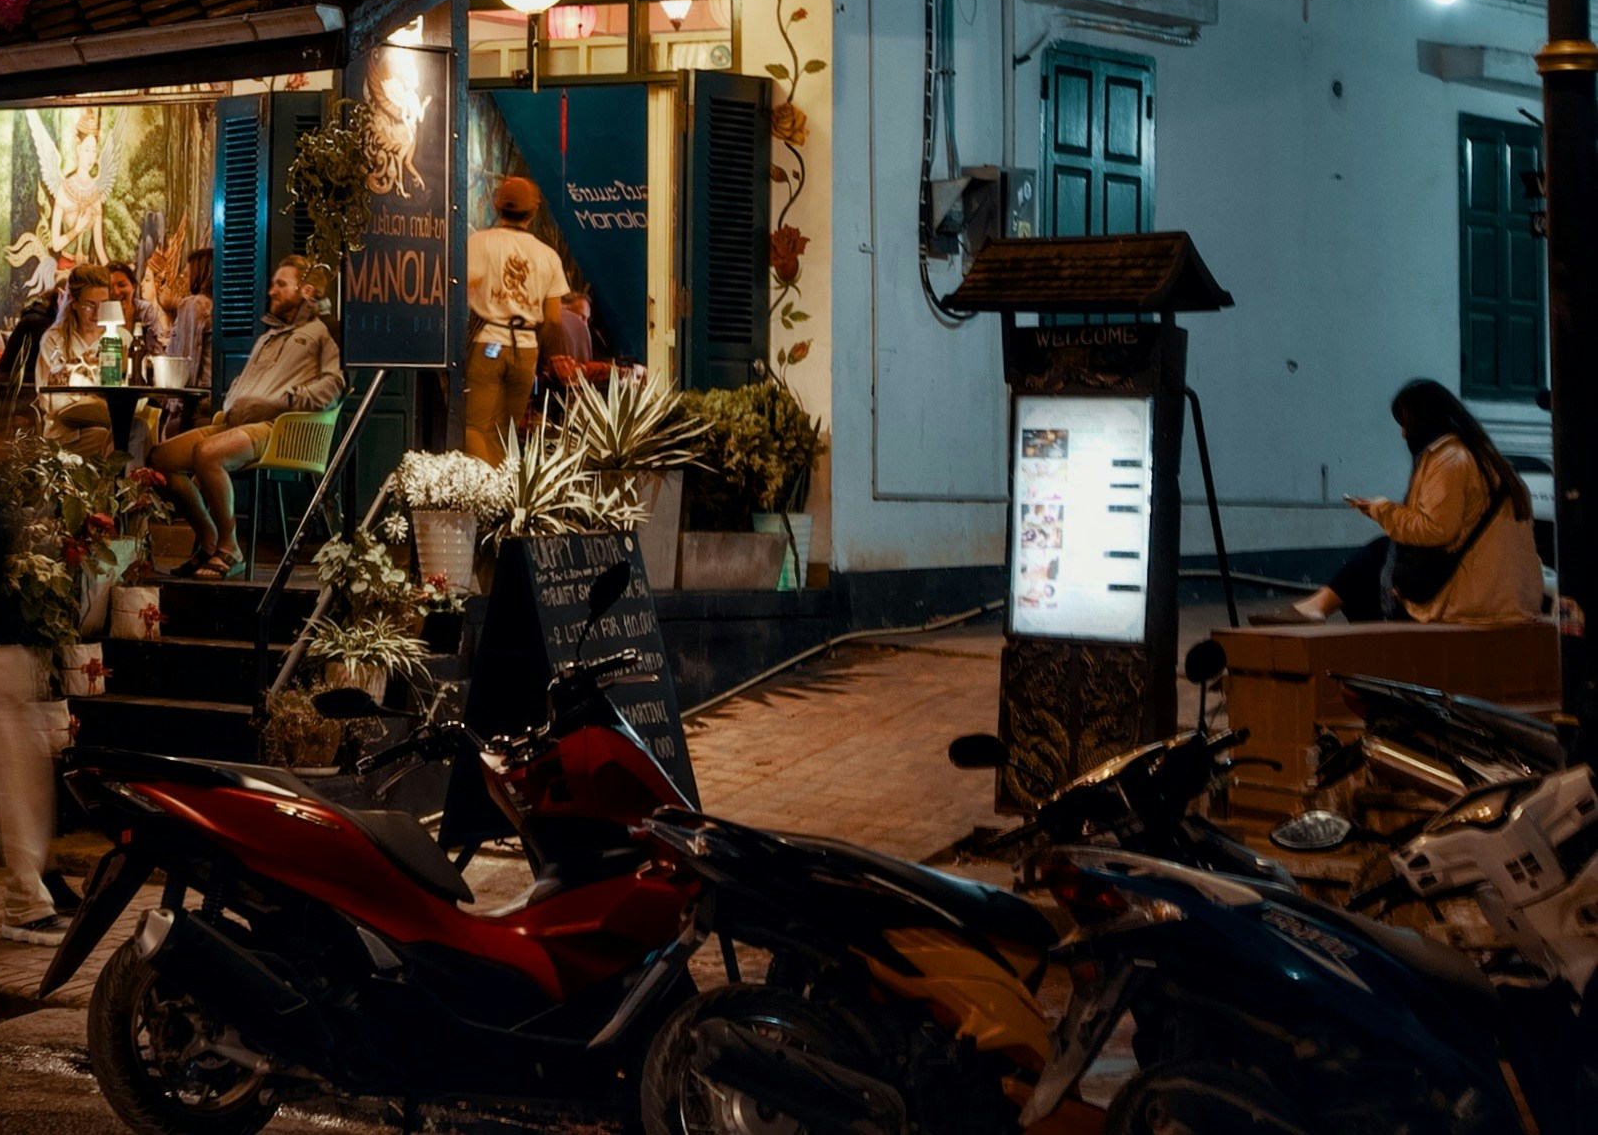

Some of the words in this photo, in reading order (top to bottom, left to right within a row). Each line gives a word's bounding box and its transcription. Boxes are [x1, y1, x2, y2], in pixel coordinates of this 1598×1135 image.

[573, 208, 649, 230] Manola
[345, 248, 445, 307] MANOLA
[1035, 325, 1139, 347] WELCOME
[600, 615, 621, 638] FOR
